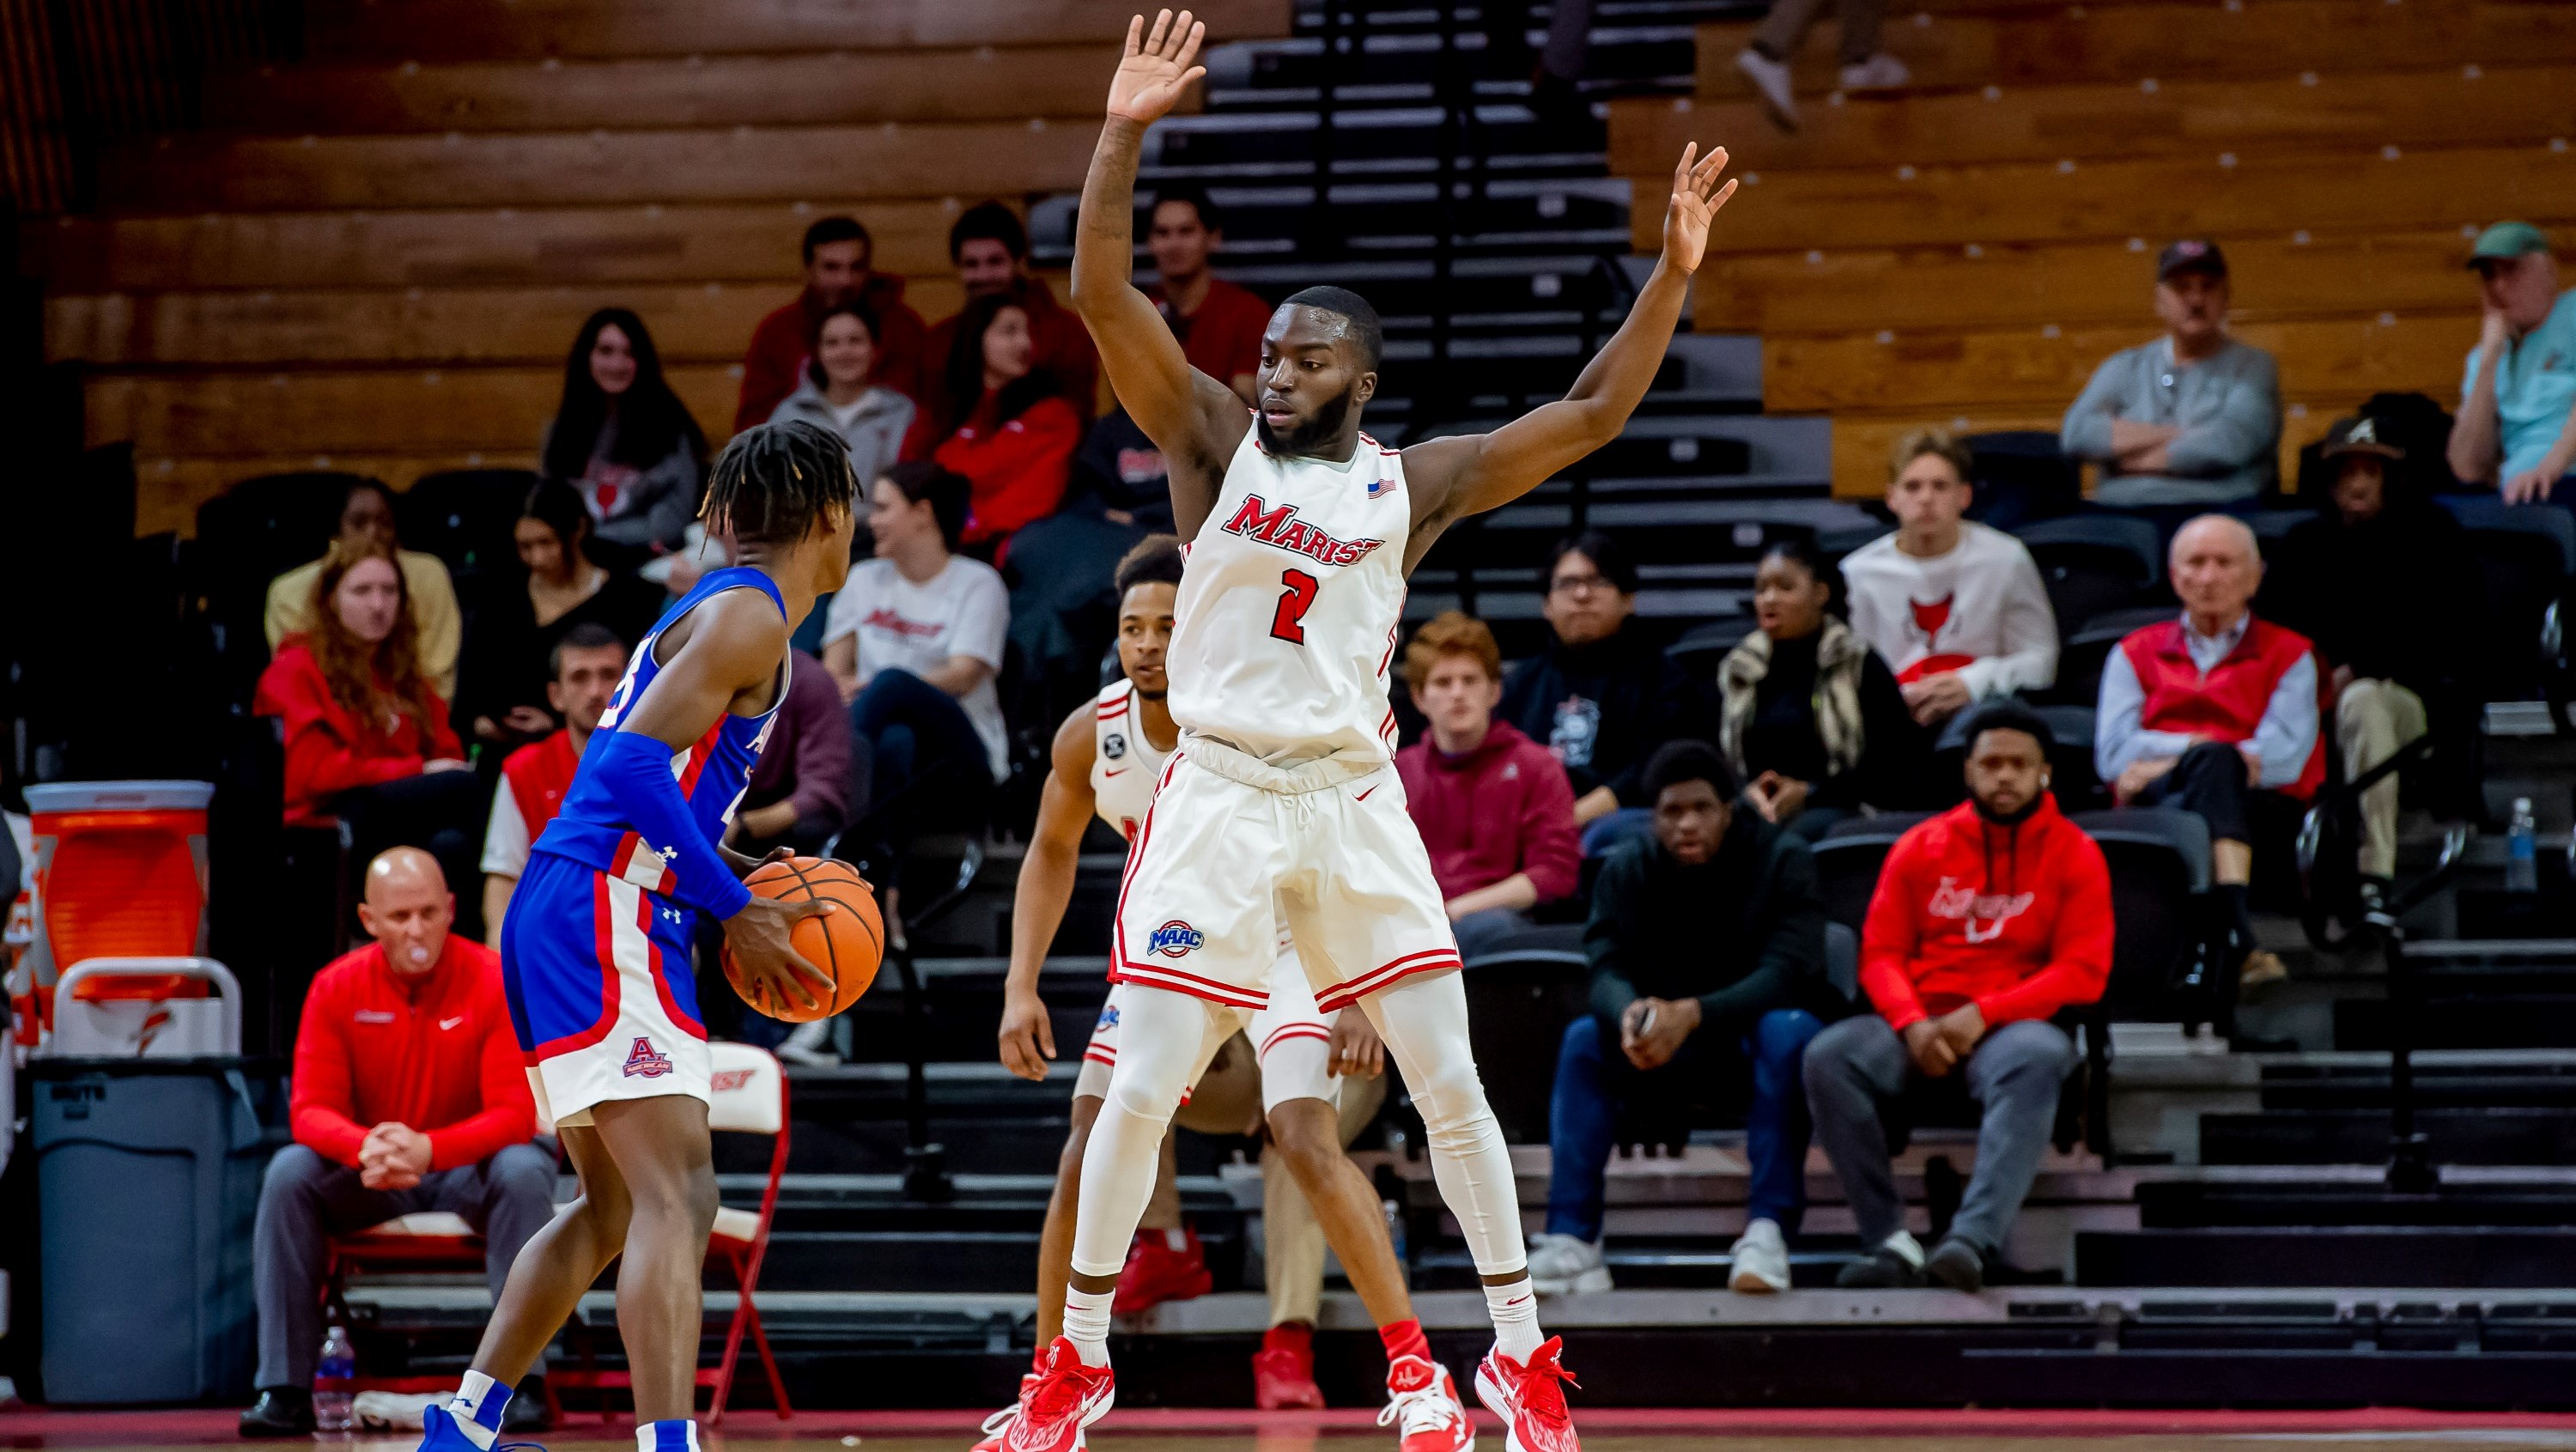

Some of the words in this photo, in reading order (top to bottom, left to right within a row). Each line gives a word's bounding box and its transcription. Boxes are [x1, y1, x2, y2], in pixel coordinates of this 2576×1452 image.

[1220, 493, 1386, 567] MARIST
[1270, 568, 1320, 647] 2
[1147, 928, 1205, 957] MAAC
